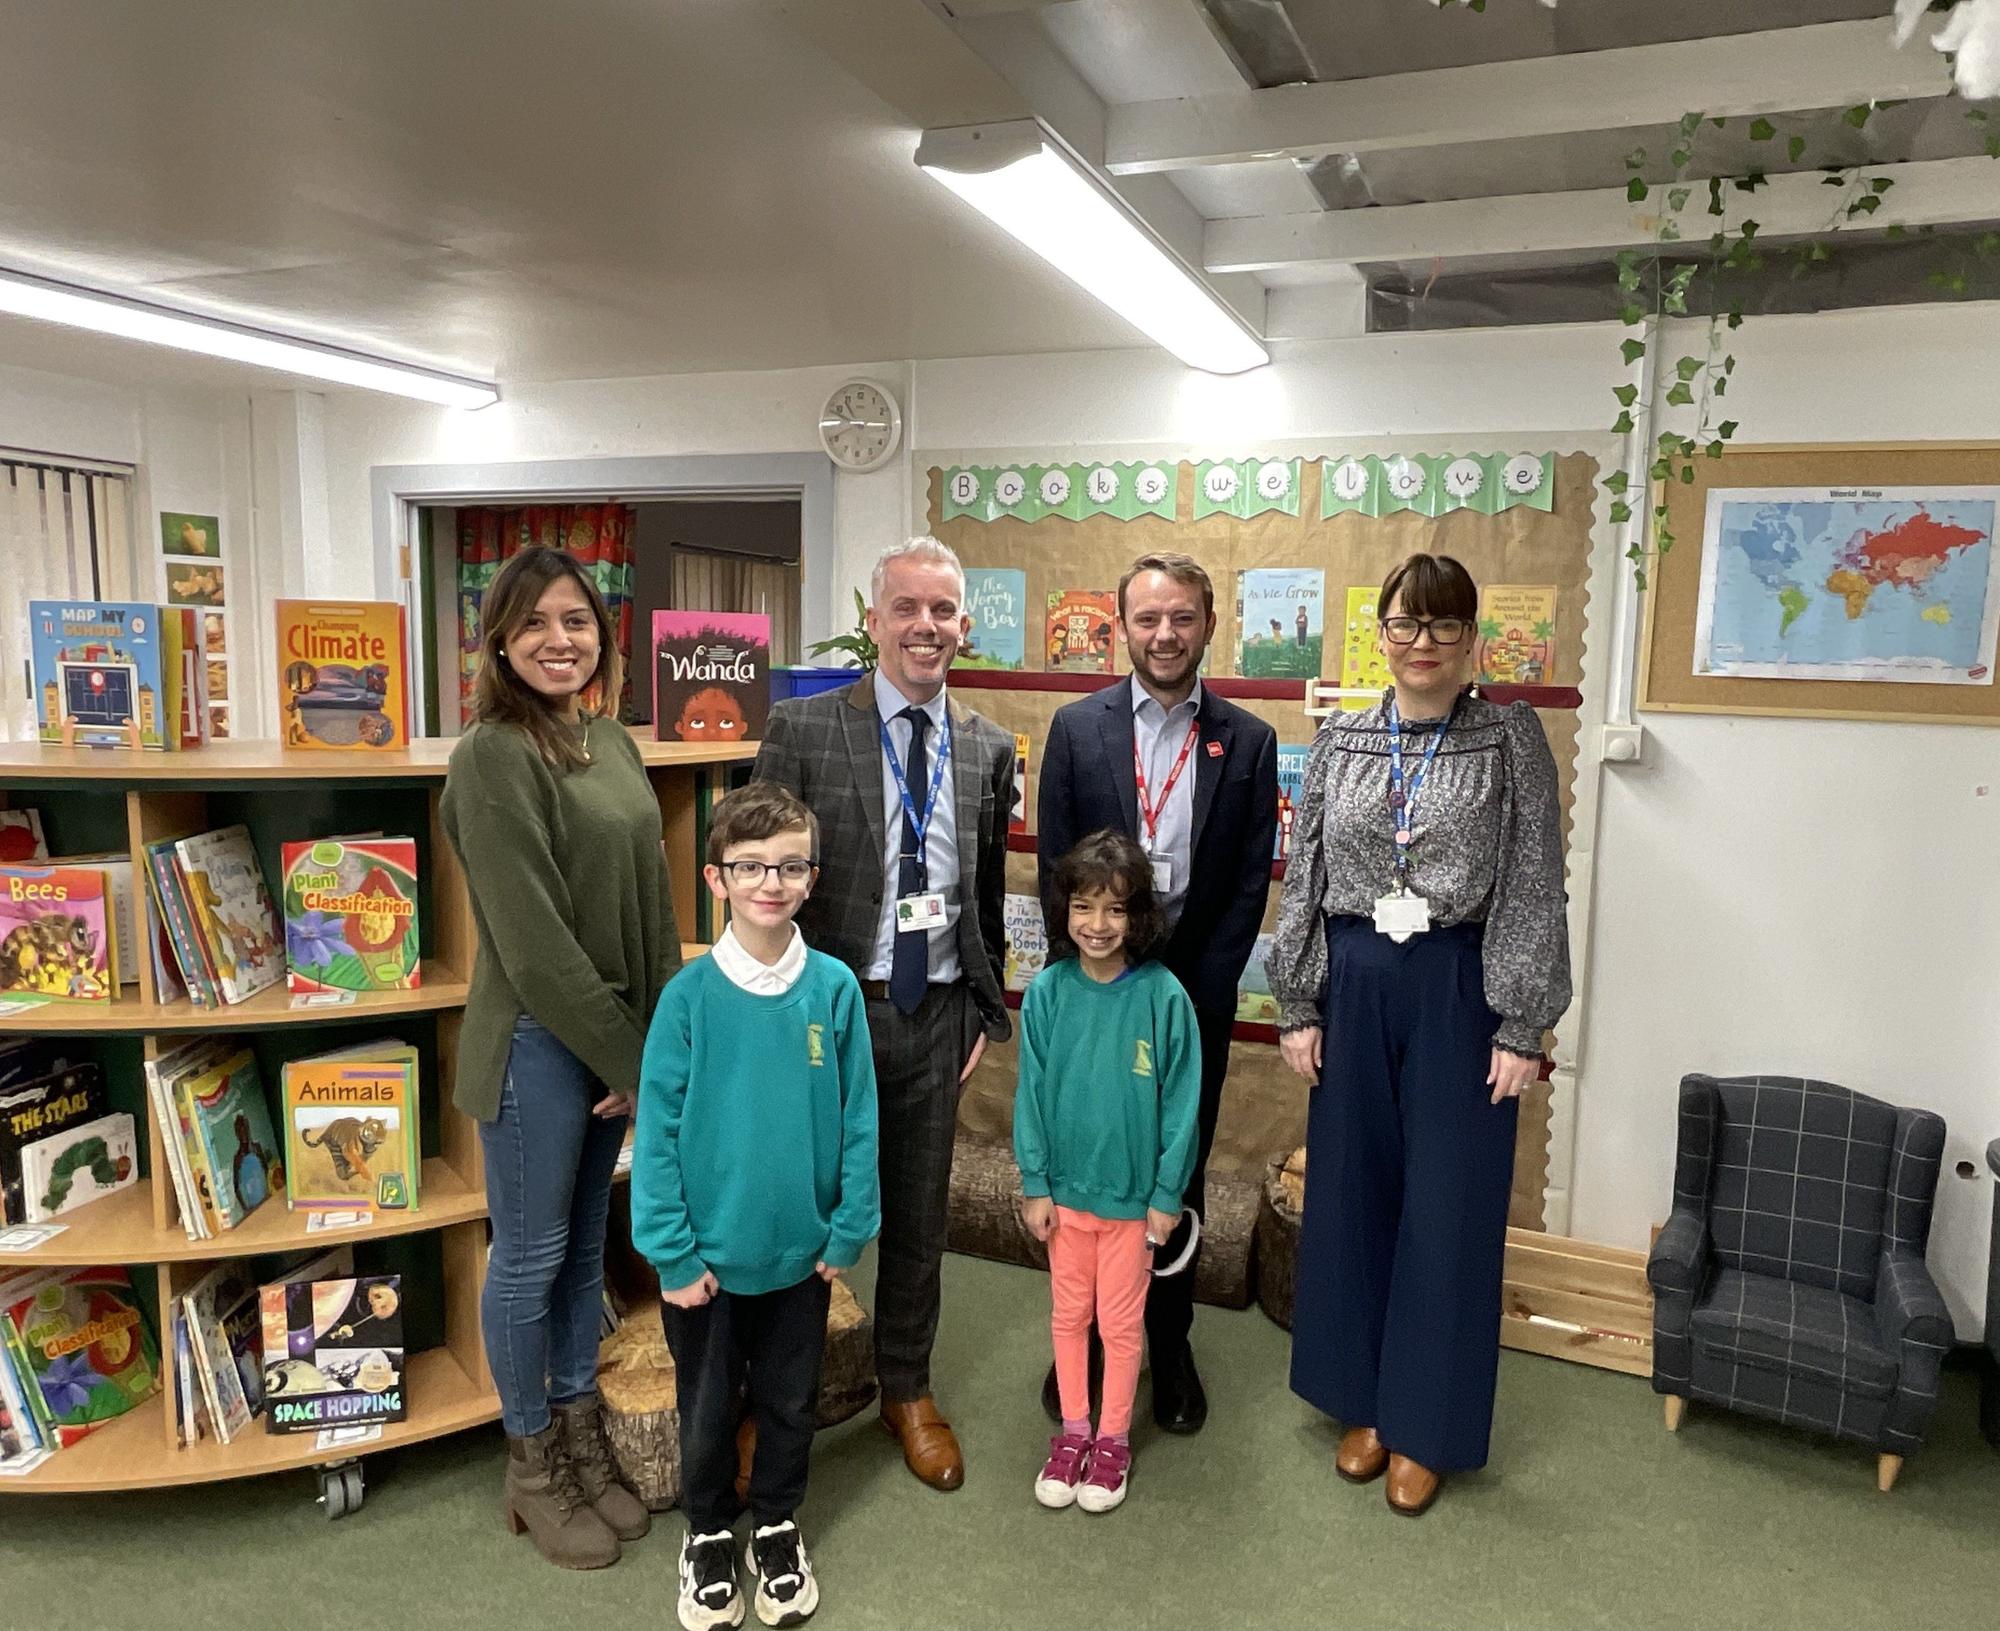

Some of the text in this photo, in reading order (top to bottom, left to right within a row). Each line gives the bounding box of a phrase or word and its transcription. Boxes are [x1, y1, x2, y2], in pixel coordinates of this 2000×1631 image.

[957, 463, 1534, 498] Books we love
[1829, 490, 1882, 499] World Map
[983, 576, 1006, 593] The
[1285, 584, 1319, 599] Grow
[61, 608, 126, 624] MAP MY
[983, 606, 1019, 629] Box
[287, 623, 386, 660] Climate
[659, 644, 755, 684] Wanda
[9, 876, 68, 902] Bees
[293, 872, 338, 891] Plant
[303, 891, 415, 915] Classification
[1015, 903, 1034, 917] The
[1004, 916, 1046, 937] emory
[299, 1080, 394, 1101] Animals
[10, 1090, 89, 1137] THE STARS
[28, 1312, 69, 1348] Plant
[43, 1306, 141, 1360] Classification
[274, 1400, 323, 1424] SPACE
[326, 1391, 402, 1417] HOPPING
